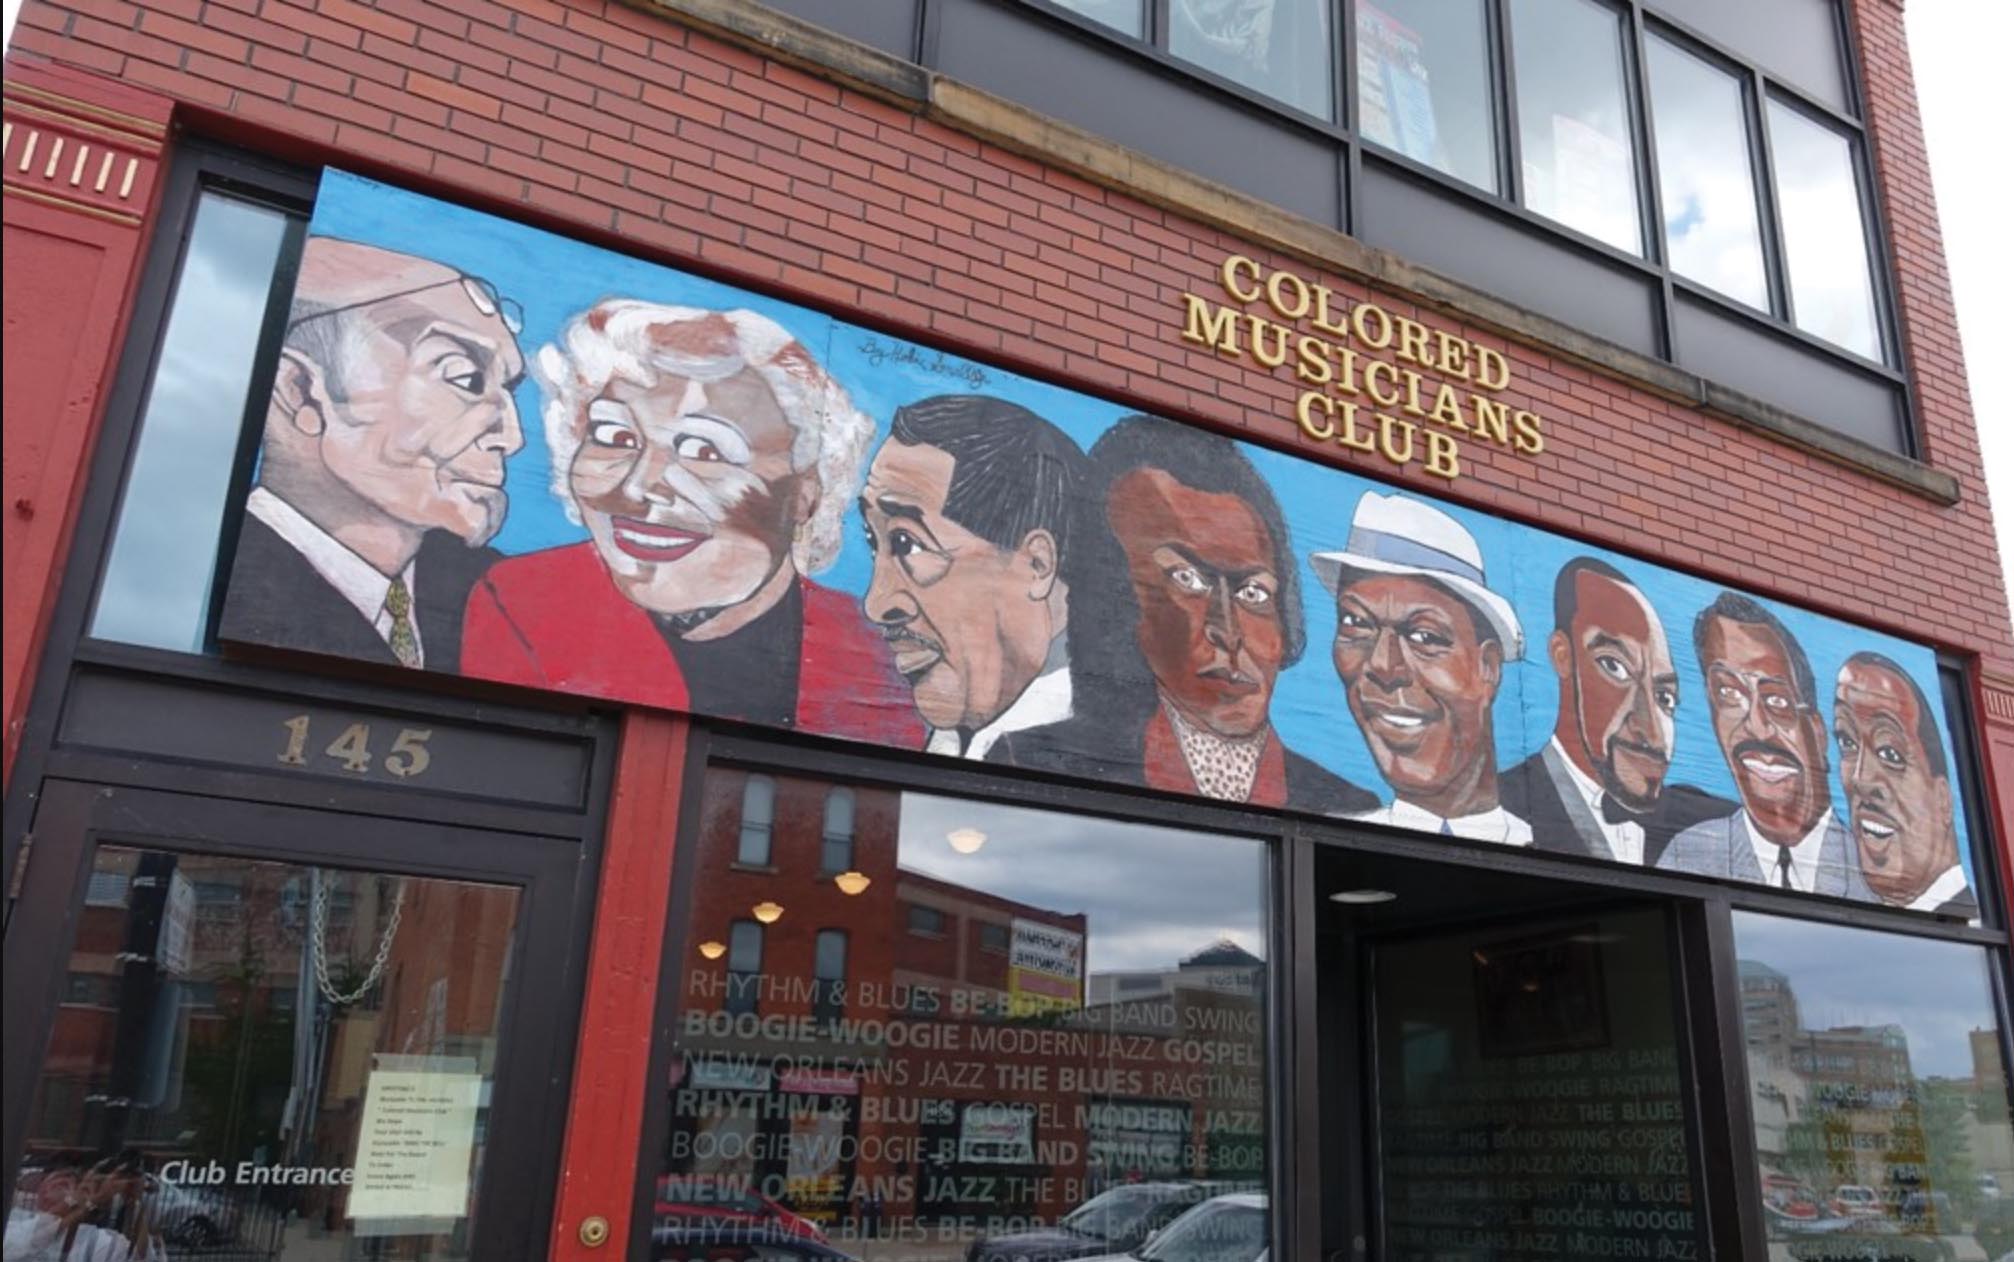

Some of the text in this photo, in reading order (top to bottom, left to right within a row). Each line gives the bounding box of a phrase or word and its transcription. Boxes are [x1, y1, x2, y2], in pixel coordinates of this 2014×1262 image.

[1221, 254, 1511, 392] COLORED
[1181, 292, 1545, 454] MUSICIANS
[1298, 390, 1461, 480] CLUB
[276, 714, 433, 778] 145
[689, 969, 821, 1005] RHYTHM
[828, 980, 849, 1007] &
[858, 981, 941, 1013] BLUES
[1110, 1001, 1178, 1028] BAND
[1184, 1006, 1262, 1034] SWING
[684, 1009, 1262, 1067] BOOGIE-WOOGIE MODERN JAZZ GOSPEL
[681, 1048, 1262, 1099] NEW ORLEANS JAZZ THE BLUES RAGTIME
[675, 1090, 820, 1122] RHYTHM
[828, 1094, 851, 1122] &
[860, 1096, 956, 1126] BLUES
[1074, 1103, 1193, 1132] MODERN
[1201, 1107, 1263, 1135] JAZZ
[1577, 1103, 1614, 1121] THE
[1086, 1140, 1177, 1169] SWING
[1183, 1143, 1264, 1170] BE-BOP
[1550, 1128, 1611, 1149] SWING
[160, 1159, 355, 1185] Club Entrance
[665, 1172, 751, 1201] NEW
[762, 1172, 915, 1203] ORLEANS
[923, 1176, 996, 1203] JAZZ
[1006, 1176, 1055, 1202] THE
[661, 1215, 801, 1246] RHYTHM
[842, 1215, 928, 1243] BLUES
[1533, 1206, 1695, 1231] BOOGIE-WOOGIE
[1566, 1231, 1649, 1258] MODERN
